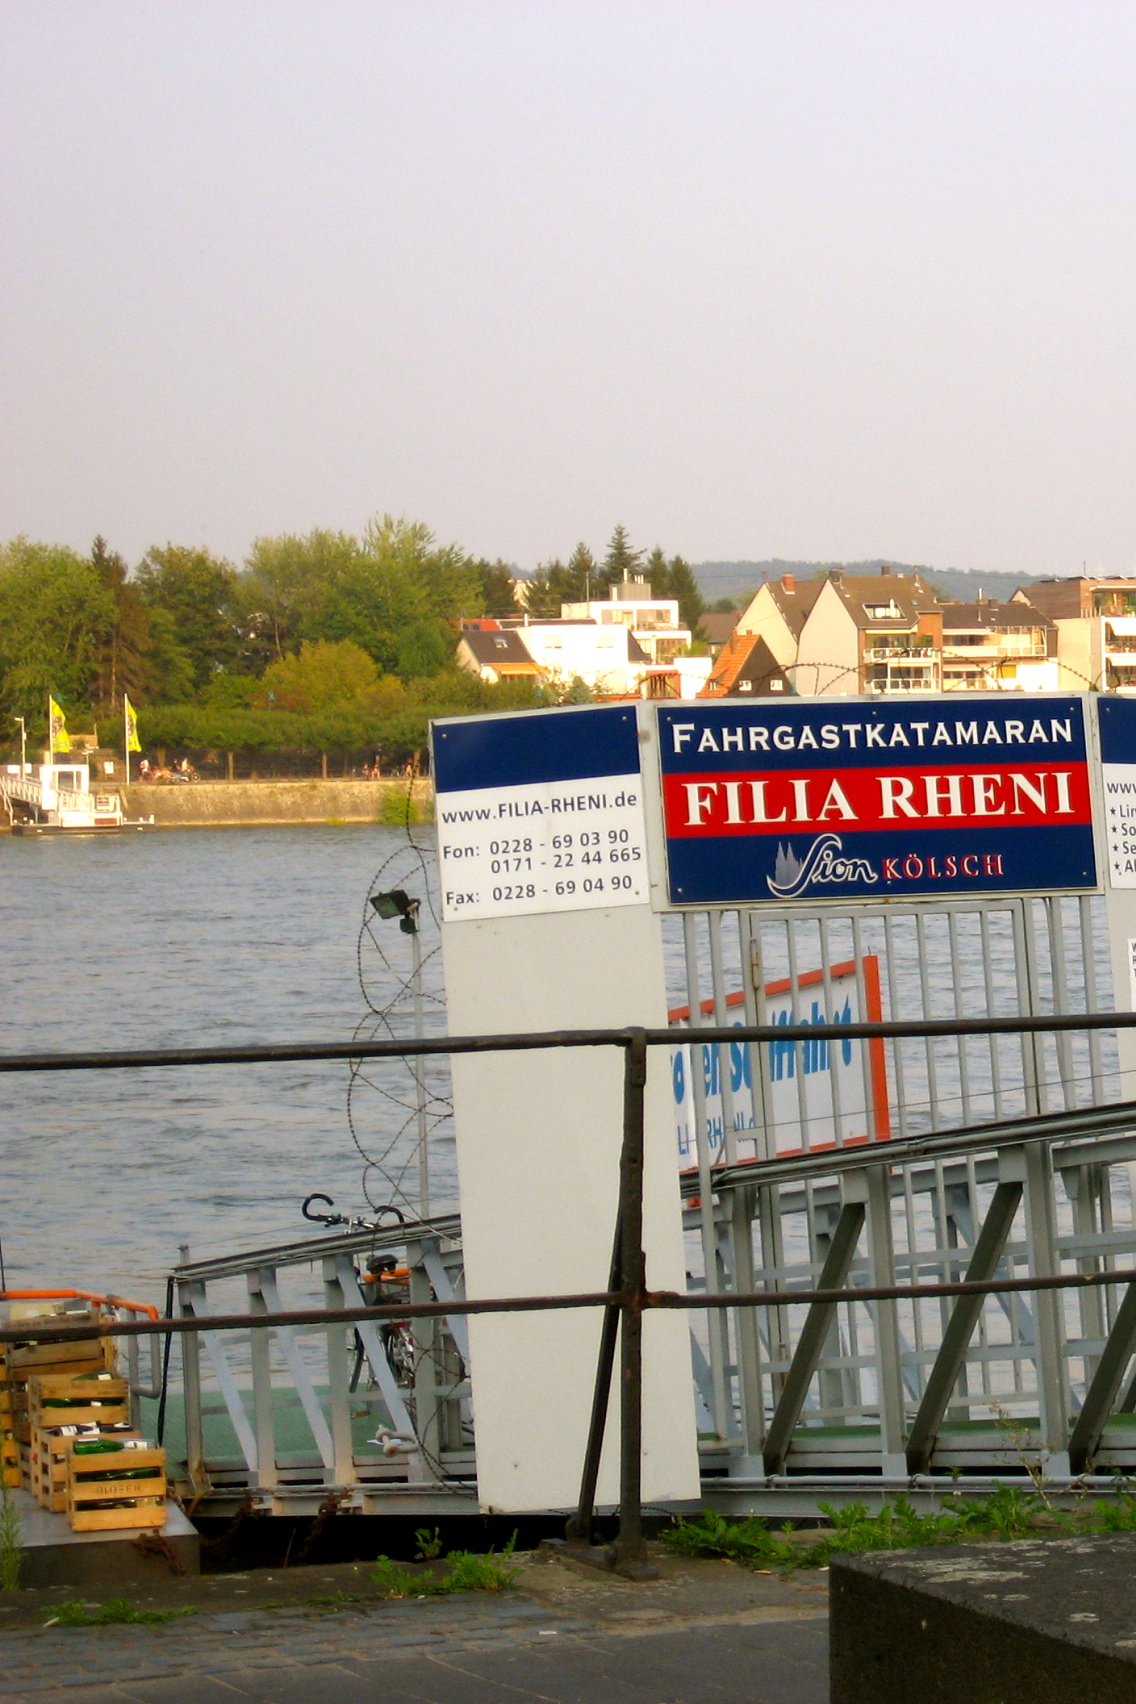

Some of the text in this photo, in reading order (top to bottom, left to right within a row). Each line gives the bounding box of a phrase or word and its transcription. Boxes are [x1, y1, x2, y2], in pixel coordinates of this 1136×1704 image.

[672, 719, 1072, 753] FAHRGASTKATAMARAN
[442, 791, 637, 823] www.FILIA-RHENI.de
[681, 772, 1075, 825] FILIA RHENI
[443, 845, 480, 859] Fon:
[490, 838, 533, 855] 0228
[552, 834, 573, 849] 69
[580, 832, 600, 847] 03
[608, 829, 629, 843] 90
[491, 857, 532, 873] 0171
[553, 853, 574, 868] 22
[581, 851, 602, 865] 44
[609, 847, 641, 863] 665
[766, 833, 1004, 898] Sion KÖLSCH
[446, 891, 480, 905] Fax:
[493, 884, 535, 900] 0228
[555, 880, 576, 895] 69
[583, 878, 604, 892] 04
[611, 875, 632, 890] 90
